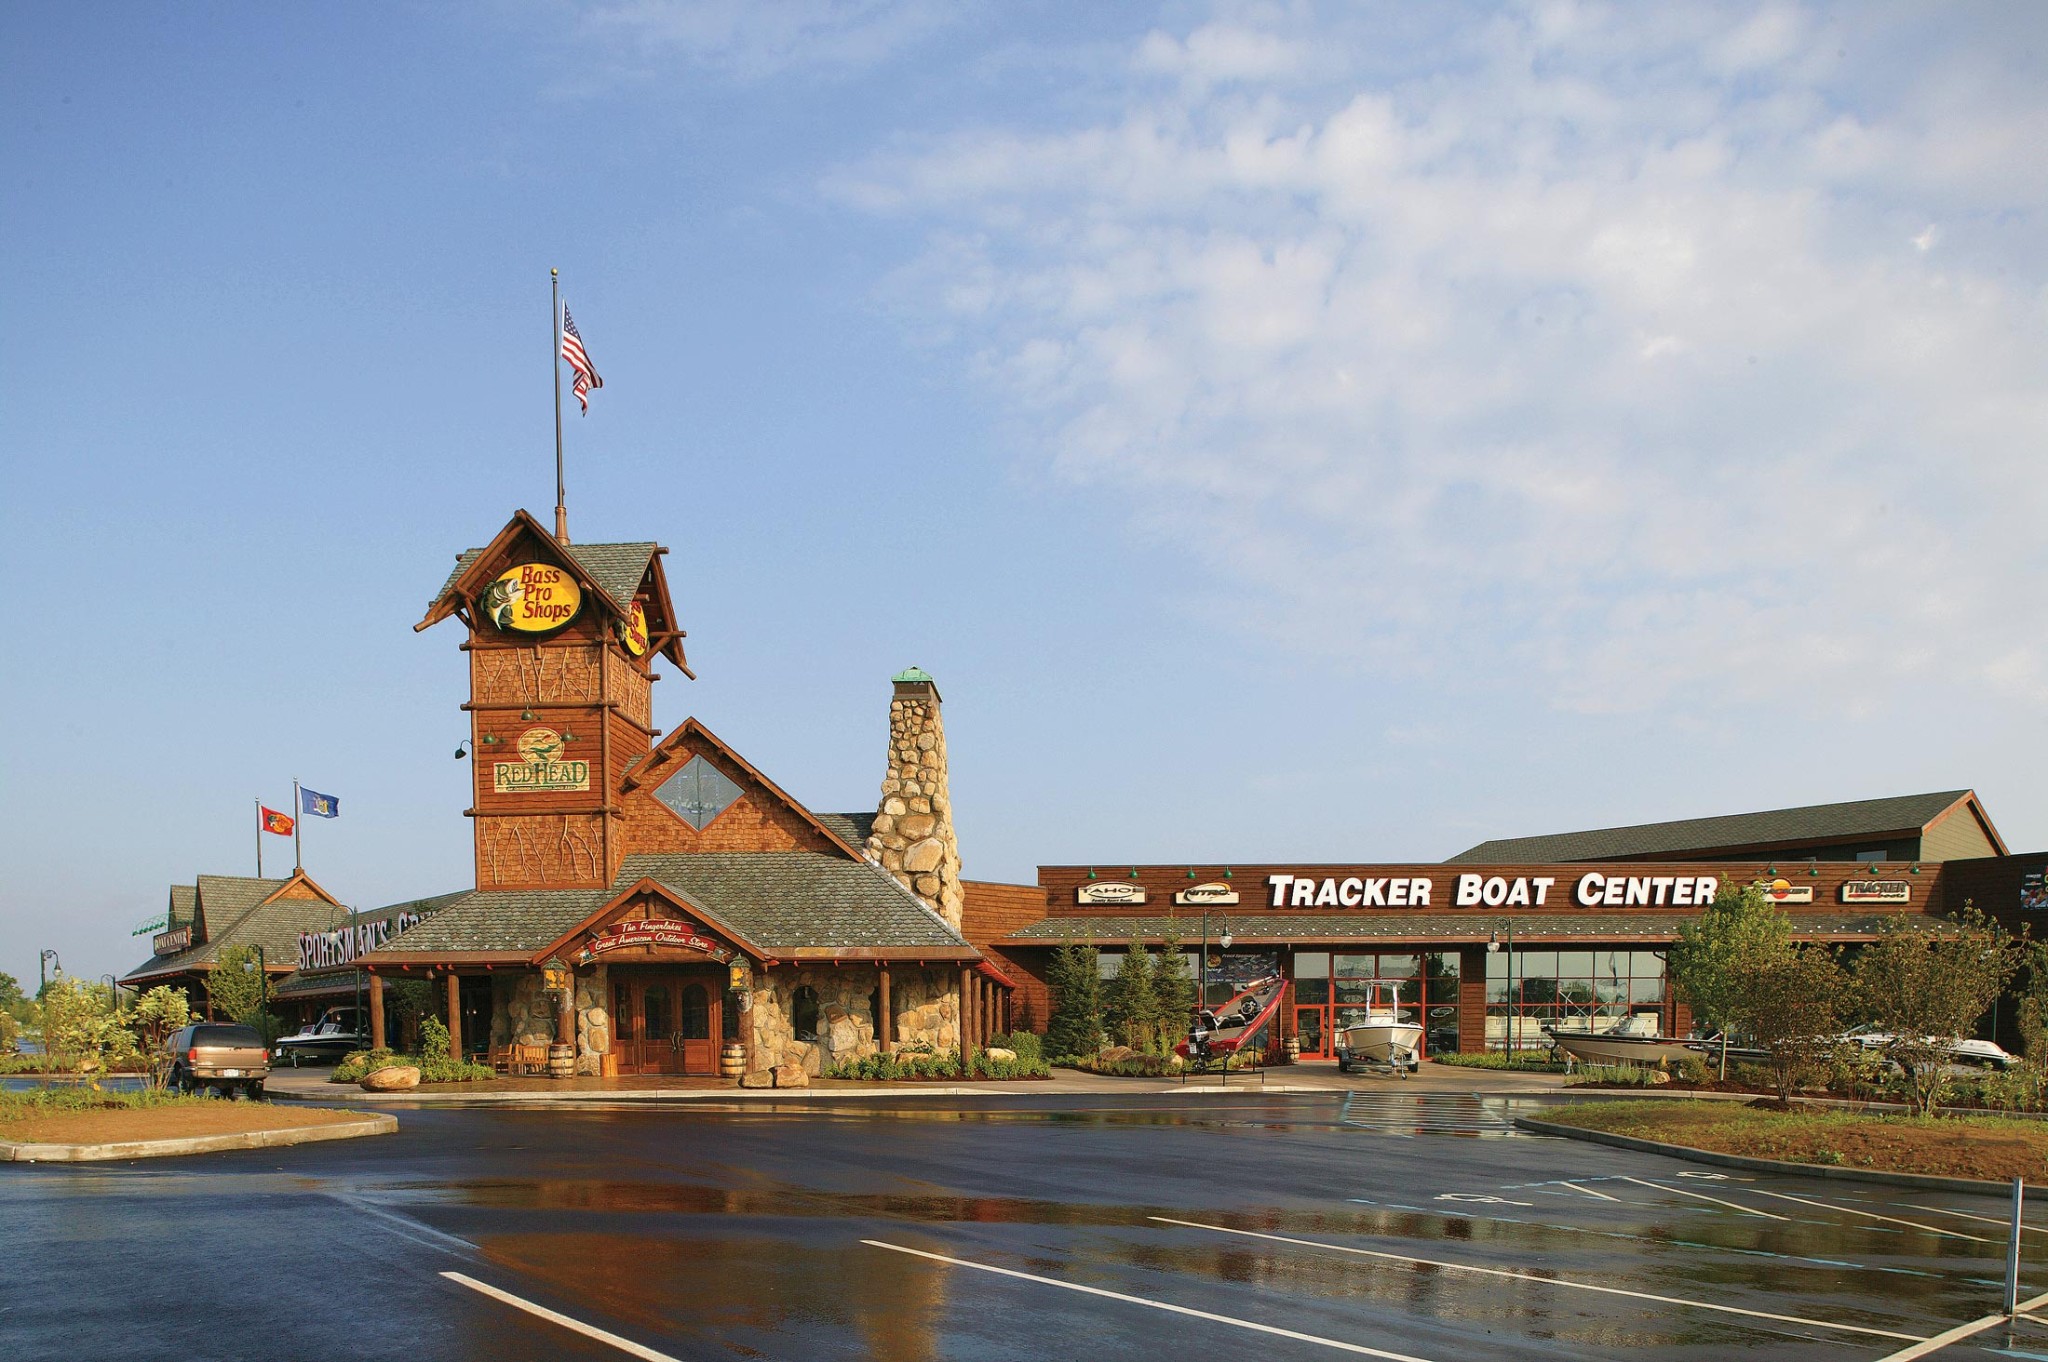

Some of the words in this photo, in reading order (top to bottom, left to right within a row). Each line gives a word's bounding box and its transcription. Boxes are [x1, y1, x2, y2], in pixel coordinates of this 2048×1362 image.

[521, 566, 560, 584] Bass
[523, 583, 552, 601] Pro
[522, 601, 572, 622] Shops
[1269, 874, 1433, 907] TRACKER
[1456, 873, 1555, 906] BOAT
[1577, 872, 1718, 906] CENTER
[1848, 882, 1907, 894] TRACKER
[622, 923, 636, 932] The
[640, 921, 682, 932] Fingerlakes
[595, 938, 616, 950] Great
[618, 934, 652, 945] American
[655, 932, 686, 944] Outdoor
[688, 936, 709, 948] Store
